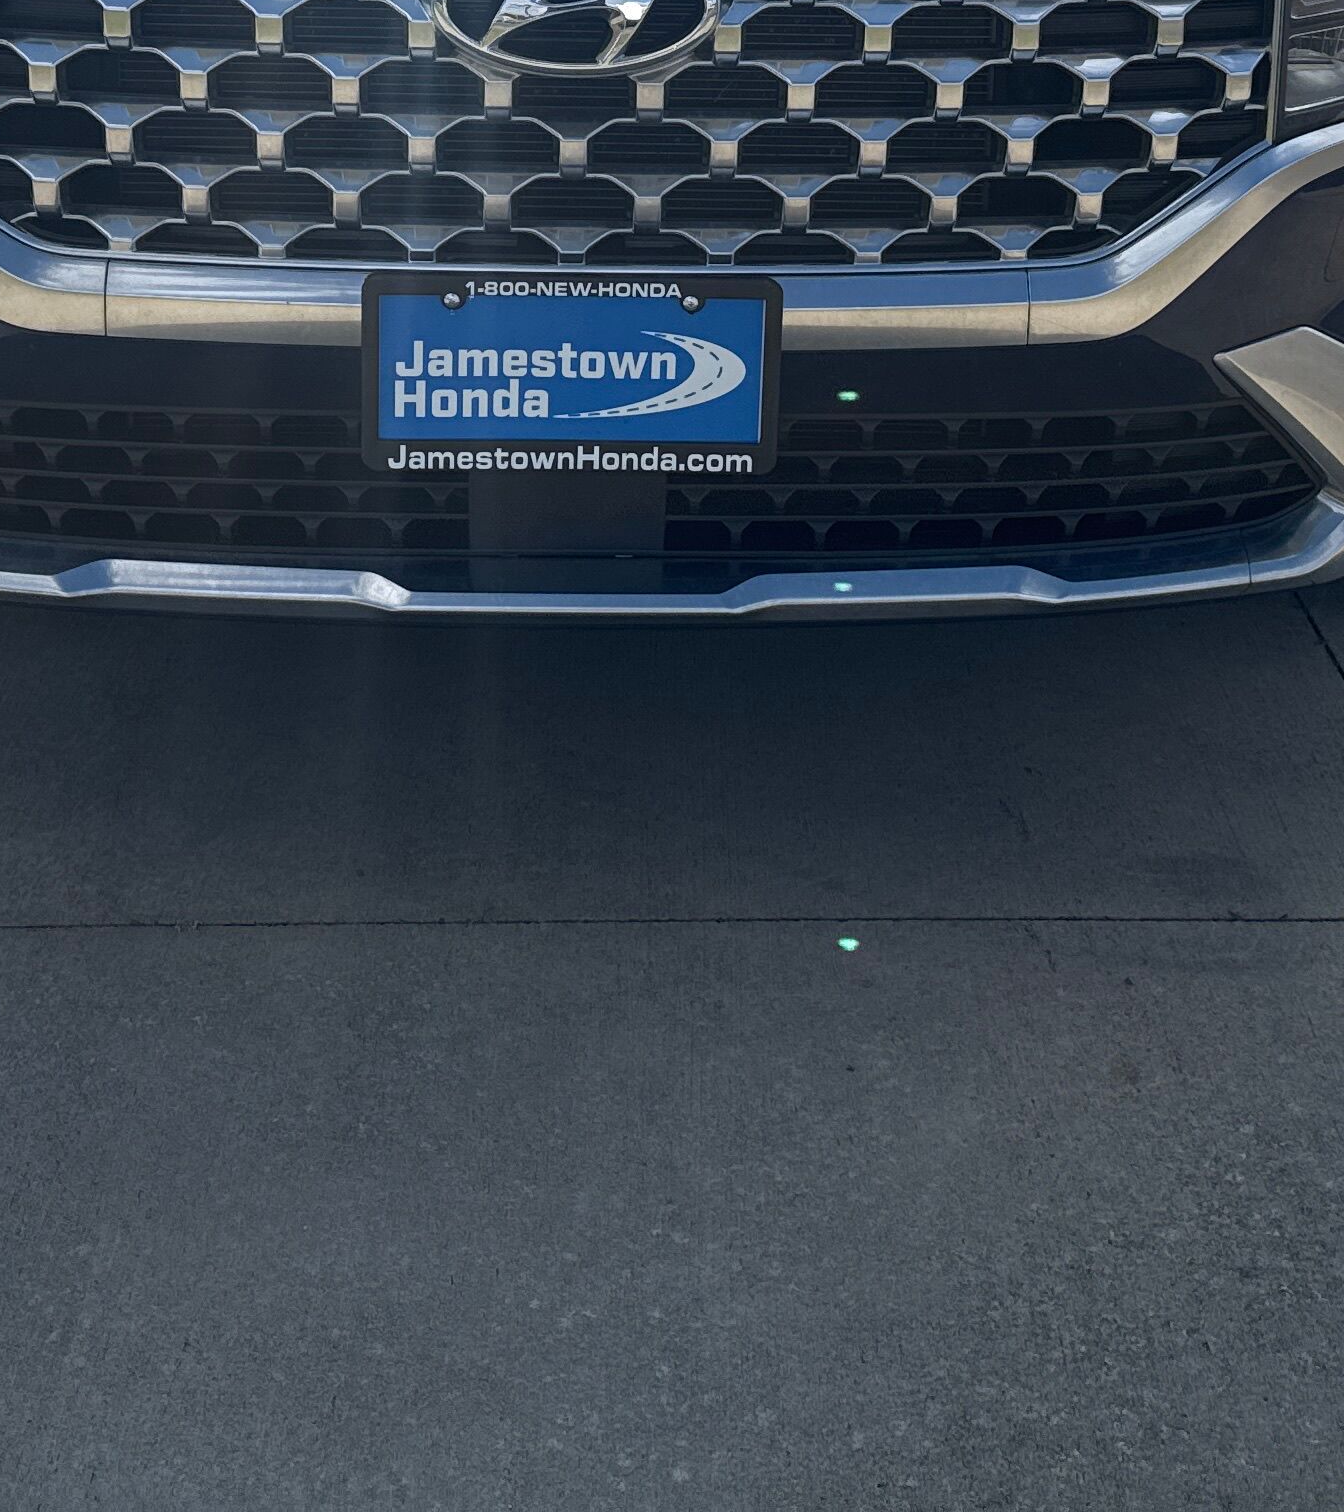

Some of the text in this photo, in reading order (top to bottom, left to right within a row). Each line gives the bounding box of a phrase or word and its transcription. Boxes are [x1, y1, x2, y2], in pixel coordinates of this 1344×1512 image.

[464, 281, 682, 299] 1-800-NEW-HONDA
[395, 340, 677, 380] Jamestown
[394, 378, 550, 419] Honda
[387, 444, 754, 473] JamestownHonda.com
